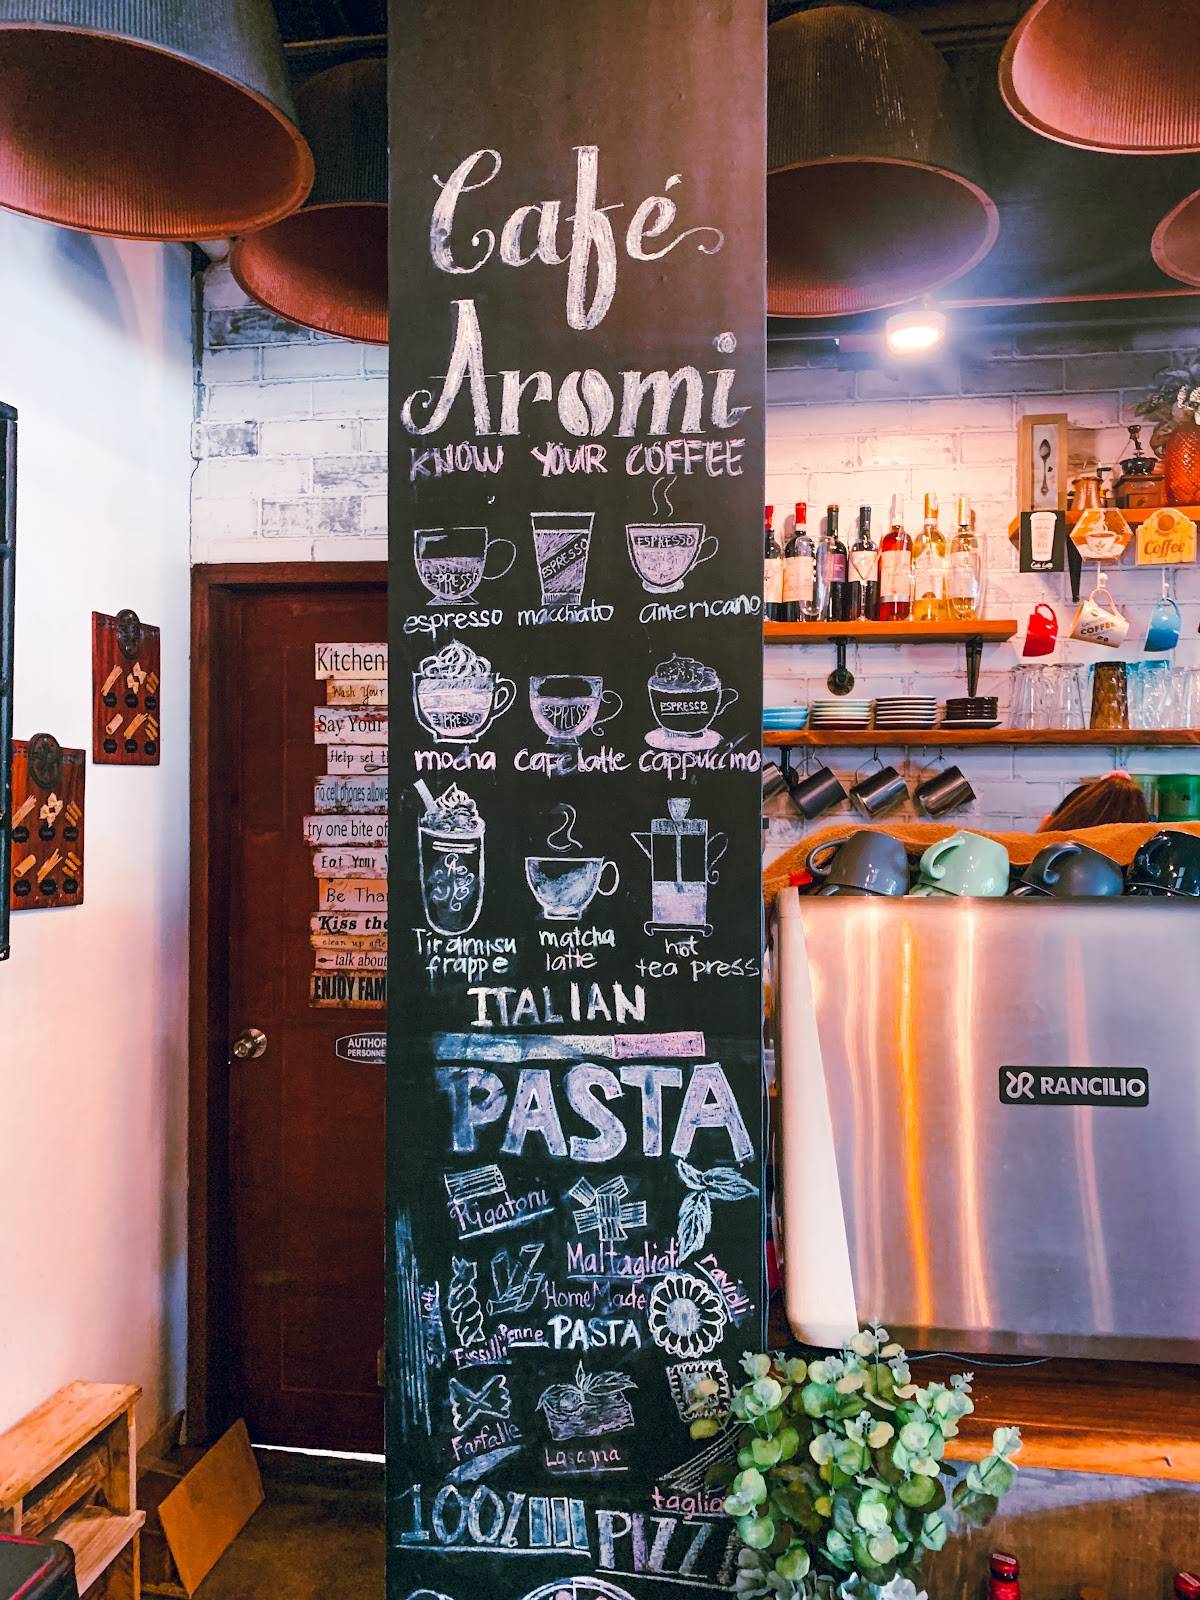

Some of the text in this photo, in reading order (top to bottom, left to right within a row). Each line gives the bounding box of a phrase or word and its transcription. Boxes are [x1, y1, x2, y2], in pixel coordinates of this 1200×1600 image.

[430, 145, 724, 330] Café
[400, 299, 752, 437] Aromi
[409, 438, 746, 480] KNOW YOUR COFFEE
[636, 534, 696, 548] ESPRESSO
[1143, 539, 1185, 558] Coffee
[541, 538, 589, 578] ESPRESSO
[517, 599, 614, 626] macchiato
[639, 595, 762, 624] americano
[403, 609, 503, 639] espresso
[318, 647, 385, 671] Kitchen
[333, 685, 384, 705] Wash Your
[659, 701, 708, 713] ESPRESSO
[318, 715, 384, 736] Say Your
[329, 749, 388, 768] Help set t
[315, 787, 324, 801] no
[327, 782, 338, 801] cell
[341, 782, 365, 803] phones
[308, 820, 388, 841] try one bite of
[322, 856, 343, 868] Eat
[352, 856, 376, 869] Your
[327, 888, 346, 902] Be
[319, 916, 357, 934] Kiss
[322, 938, 346, 946] clean
[352, 941, 364, 950] up
[411, 928, 517, 957] Tiramisu
[539, 926, 616, 949] matcha
[665, 938, 699, 957] hot
[336, 952, 387, 967] talk about
[426, 955, 509, 983] frappe
[546, 949, 598, 972] latte
[636, 958, 760, 982] tea press
[314, 976, 387, 1000] ENJOY FAM
[467, 981, 646, 1027] ITALIAN
[1040, 1076, 1146, 1097] RANCILIO
[435, 1062, 754, 1162] PASTA
[448, 1189, 550, 1231] Rigatoni
[498, 1324, 543, 1342] Penne
[547, 1314, 641, 1350] PASTA
[451, 1423, 522, 1461] Farfalle
[396, 1484, 526, 1548] 100%
